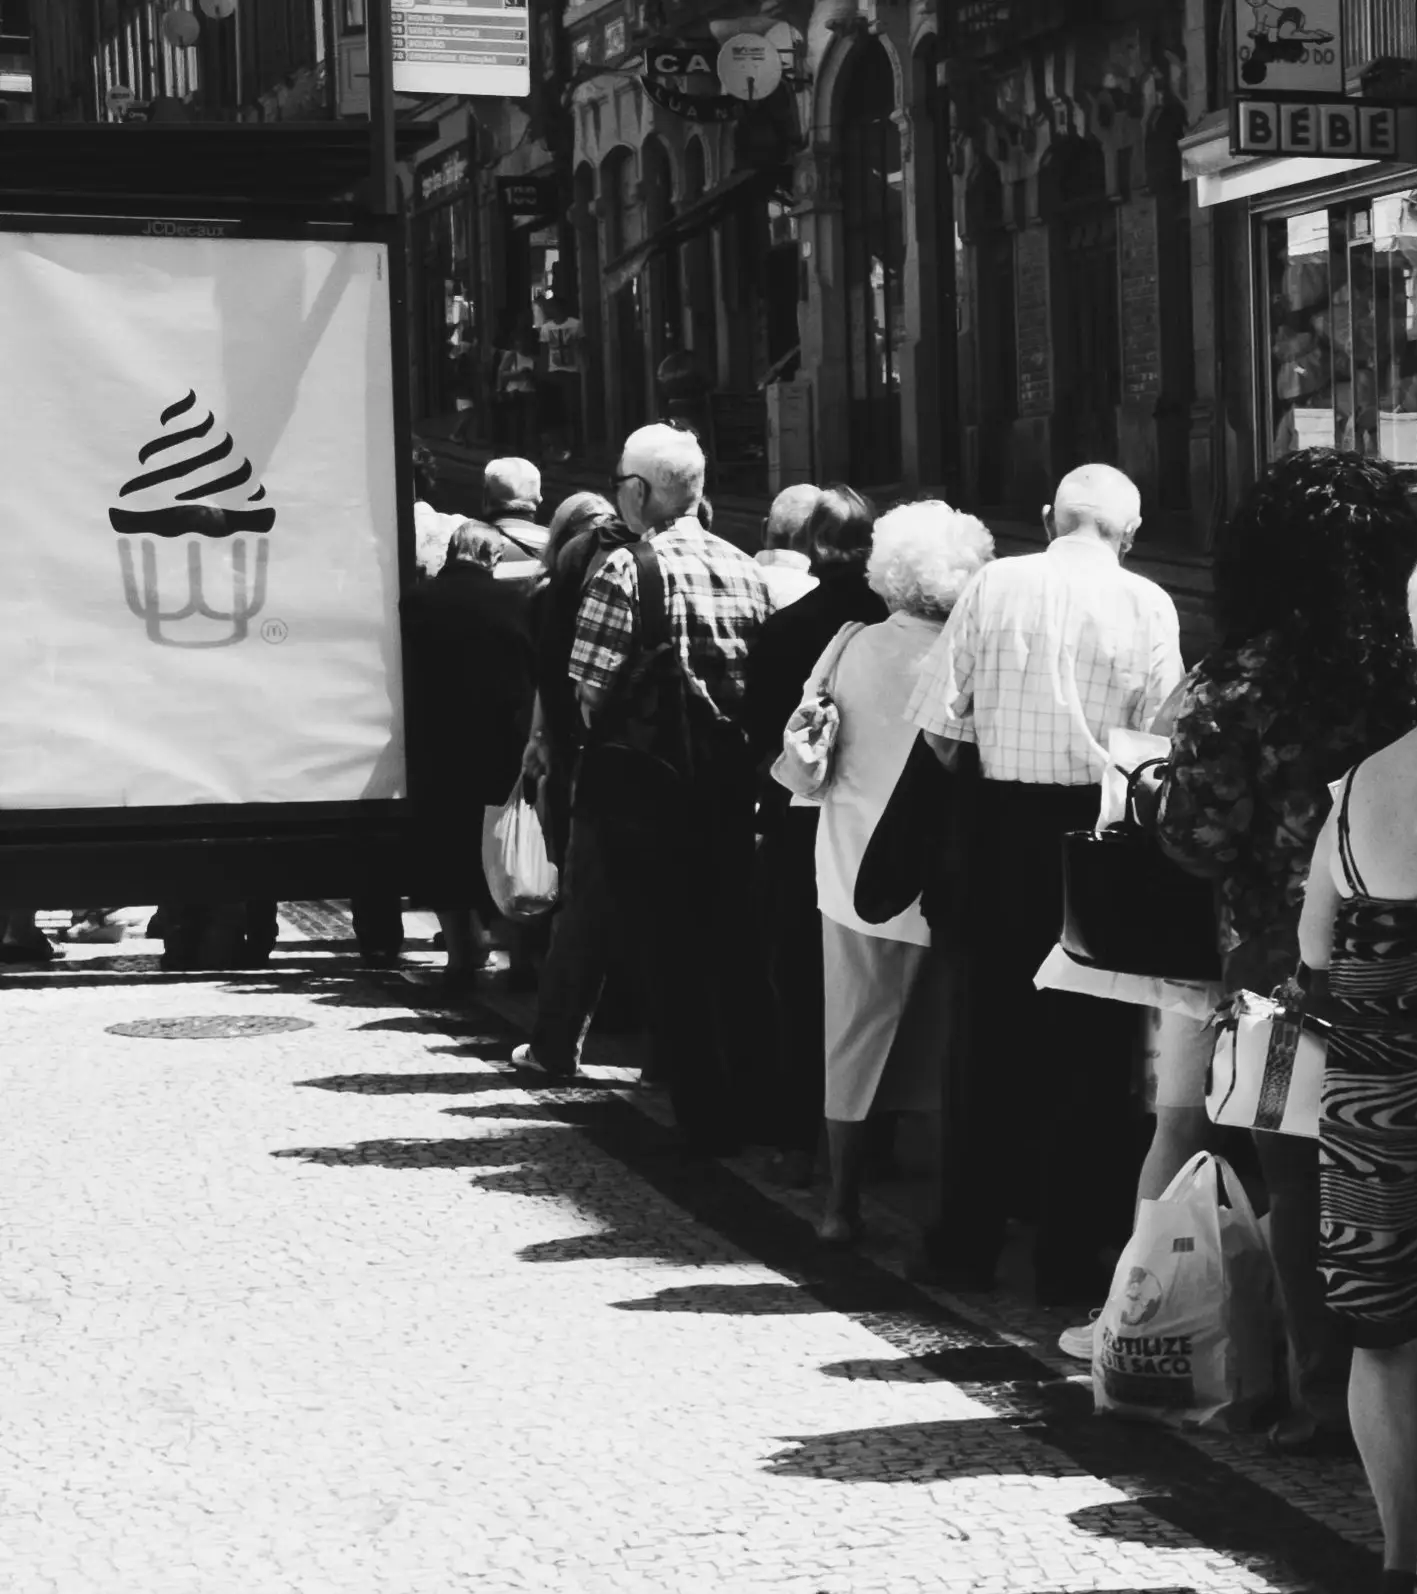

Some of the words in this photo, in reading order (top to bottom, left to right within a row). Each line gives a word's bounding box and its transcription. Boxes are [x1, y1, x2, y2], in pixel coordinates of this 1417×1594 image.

[1313, 48, 1335, 64] DO
[142, 221, 225, 237] JCDecaux
[1131, 1356, 1192, 1375] SACO
